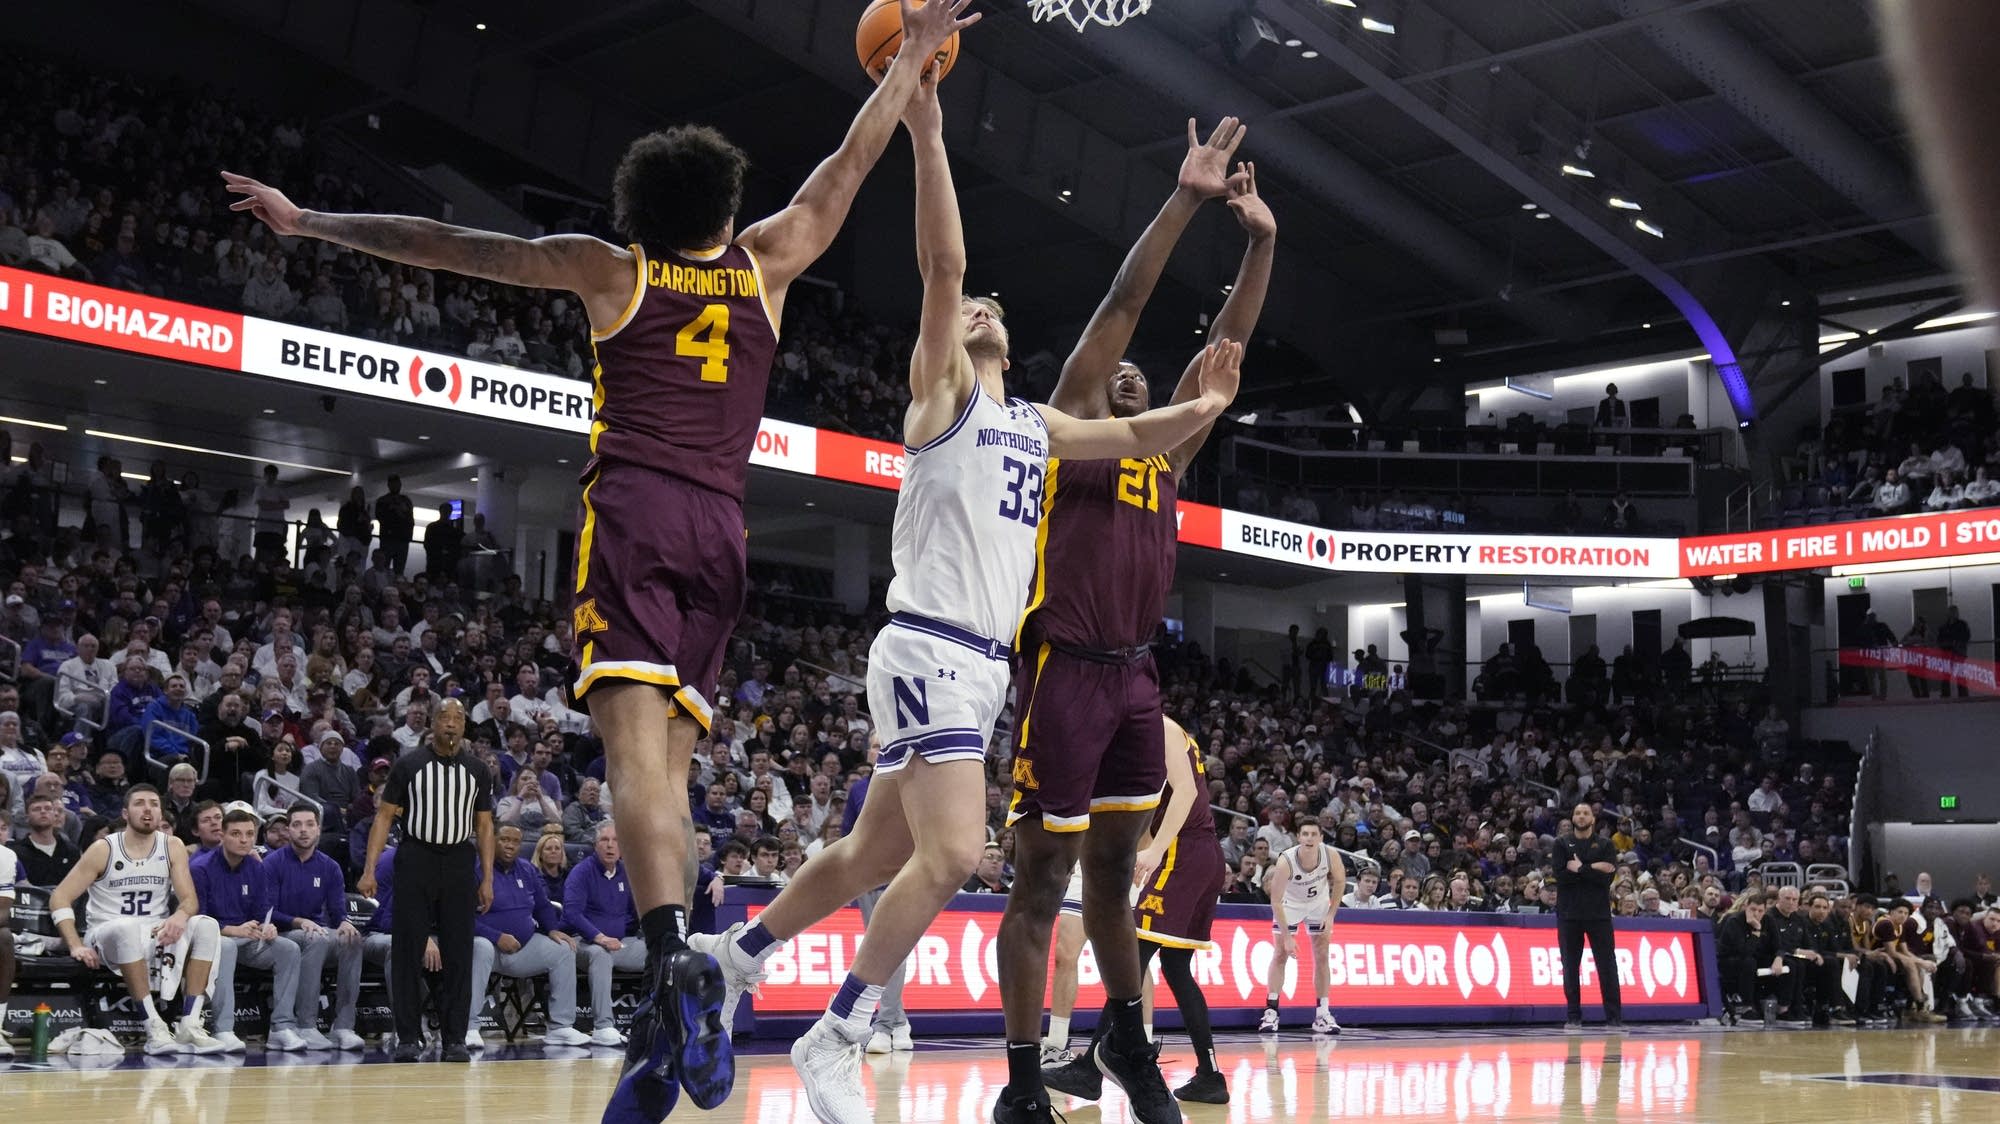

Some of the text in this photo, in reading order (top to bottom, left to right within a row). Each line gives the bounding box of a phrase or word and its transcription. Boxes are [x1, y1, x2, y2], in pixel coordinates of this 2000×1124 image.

[647, 260, 758, 297] CARRINGTON
[47, 291, 233, 353] BIOHAZARD
[281, 339, 400, 385] BELFOR
[675, 304, 730, 383] 4
[999, 455, 1042, 528] 33
[1118, 458, 1158, 513] 21
[1242, 524, 1649, 566] BELFOR PROPERTY RESTORATION
[1686, 542, 1762, 567] WATER
[1787, 535, 1837, 559] FIRE
[1862, 522, 1930, 552] MOLD
[893, 676, 930, 730] N
[21, 893, 30, 905] N
[120, 890, 153, 916] 32
[350, 901, 358, 912] N
[1138, 894, 1165, 915] M
[1306, 886, 1317, 898] 5
[1328, 943, 1448, 986] BELFOR
[1530, 947, 1636, 986] BEFR
[8, 1008, 82, 1020] ROHMAN
